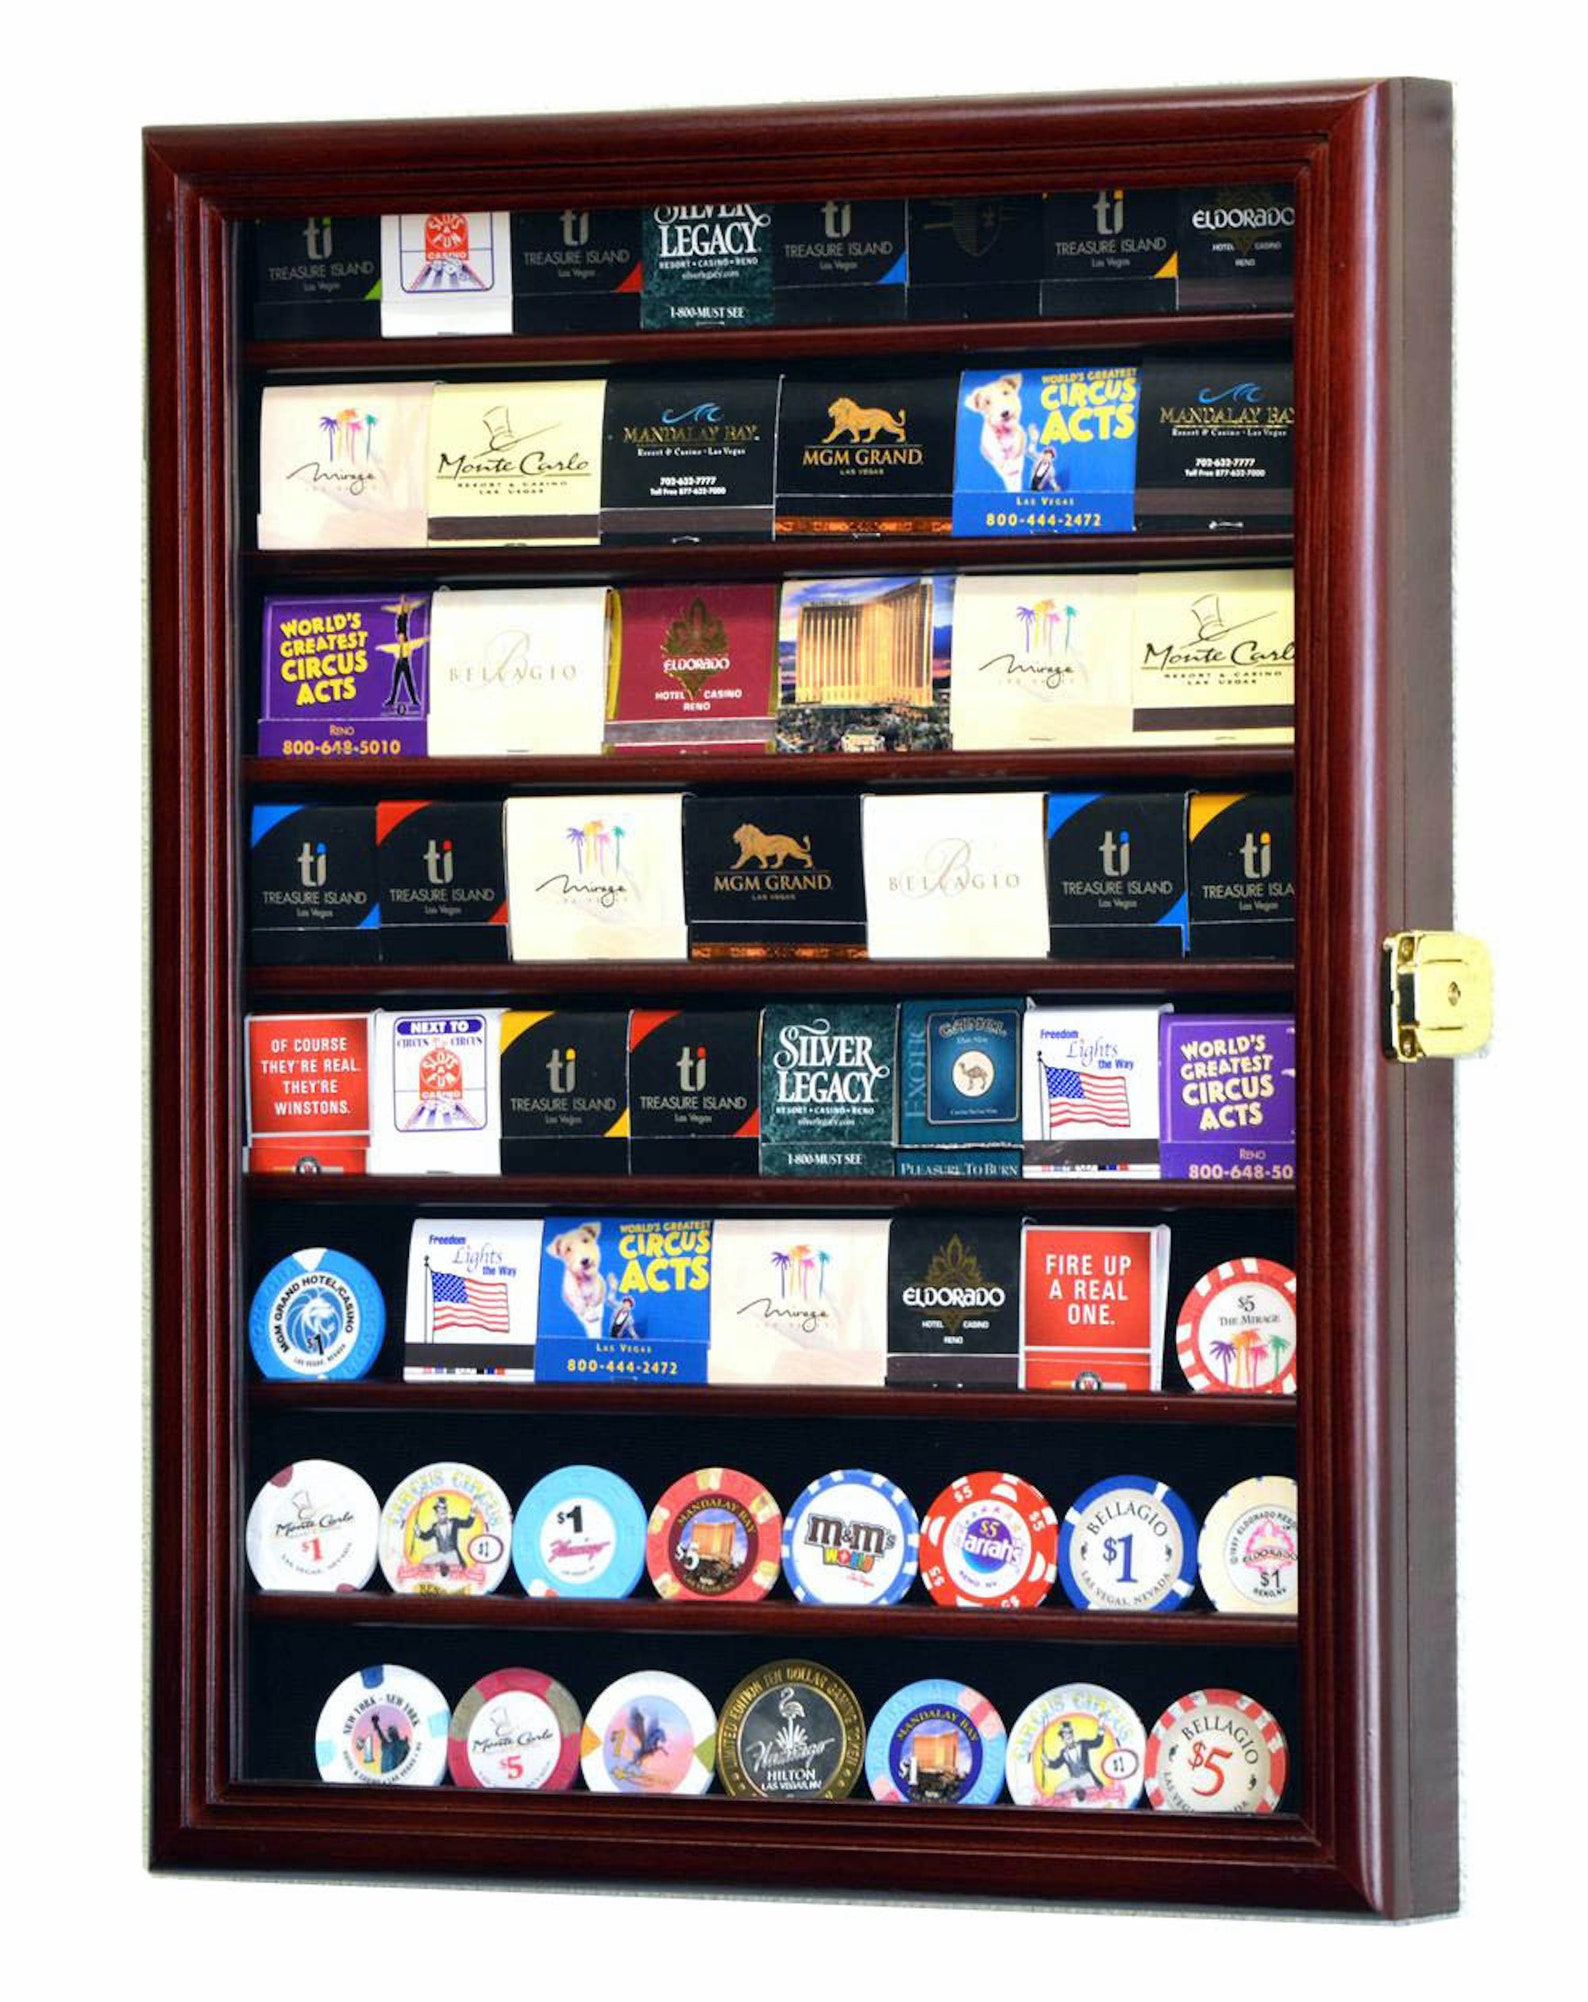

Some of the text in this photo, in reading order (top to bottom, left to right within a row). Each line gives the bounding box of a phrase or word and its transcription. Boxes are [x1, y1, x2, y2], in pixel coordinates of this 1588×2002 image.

[658, 221, 762, 258] LEGACY
[1055, 237, 1166, 256] TREASURE ISLAND
[524, 249, 630, 266] TREASURE ISLAND
[785, 241, 893, 258] TREASURE ISLAND
[268, 261, 374, 280] TREASURE ISLAND
[659, 256, 758, 269] RESORT CASINO RENO
[671, 306, 745, 318] 1-800-MUST SEE
[1041, 368, 1137, 384] WORLD'S GREATEST
[1041, 376, 1137, 410] CIRCUS
[1040, 403, 1135, 445] ACTS
[1172, 429, 1199, 437] Resort
[1211, 428, 1240, 437] Casino
[1247, 428, 1262, 437] Las
[1263, 428, 1287, 438] Vegas
[623, 426, 720, 443] MANDALAY
[637, 448, 663, 457] Resort
[674, 448, 701, 456] Casino
[707, 447, 722, 456] Las
[723, 447, 746, 457] Vegas
[802, 448, 922, 466] MGM GRAND
[437, 451, 590, 480] Monte Carlo
[1195, 458, 1255, 469] 702-632-7777
[659, 476, 716, 487] 702-632-7777
[986, 513, 1102, 528] 800-444-2472
[280, 612, 361, 639] WORLD'S
[280, 630, 368, 658] GREATEST
[281, 650, 369, 682] CIRCUS
[449, 665, 577, 683] BELLAGIO
[295, 678, 356, 706] ACTS
[655, 689, 742, 701] HOTEL CASINO
[683, 702, 711, 711] RENO
[282, 739, 401, 755] 800-648-5010
[423, 839, 454, 886] ti
[1099, 831, 1130, 877] ti
[1240, 832, 1271, 879] ti
[297, 842, 326, 887] ti
[713, 875, 831, 891] MGM GRAND
[888, 873, 1020, 892] BELLAGIO
[1063, 881, 1173, 896] TREASURE ISLAND
[263, 890, 367, 904] TREASURE ISLAND
[390, 889, 495, 903] TREASURE ISLAND
[1098, 899, 1137, 910] Las Vegas
[297, 909, 333, 920] Las Vegas
[425, 905, 462, 917] Las Vegas
[1239, 900, 1278, 912] Las Vegas
[410, 1019, 469, 1035] NEXT TO
[1040, 1029, 1079, 1039] Freedom
[271, 1037, 348, 1053] OF COURSE
[397, 1036, 483, 1049] CIRCUS CIRCUS
[773, 1018, 890, 1079] SILVER
[1066, 1036, 1119, 1067] Lights
[1181, 1034, 1266, 1061] WORLD'S
[261, 1057, 362, 1074] THEY'RE REAL.
[546, 1048, 576, 1094] ti
[676, 1046, 706, 1092] ti
[1098, 1059, 1135, 1071] the Way
[1181, 1054, 1274, 1081] GREATEST
[282, 1079, 338, 1095] THEY'RE
[421, 1090, 461, 1101] CASINO
[776, 1070, 877, 1104] LEGACY
[1182, 1075, 1276, 1107] CIRCUS
[274, 1101, 351, 1116] WINSTONS.
[510, 1098, 616, 1112] TREASURE ISLAND
[640, 1096, 747, 1111] TREASURE ISLAND
[776, 1106, 874, 1115] RESORT CASINO RENO
[1199, 1102, 1264, 1131] ACTS
[788, 1154, 863, 1165] 1-800-MUST SEE
[1188, 1164, 1294, 1180] 800-648-50
[619, 1220, 711, 1233] WORLD'S GREATEST
[429, 1234, 466, 1246] Freedom
[619, 1230, 710, 1259] CIRCUS
[452, 1242, 503, 1273] Lights
[1045, 1254, 1132, 1277] FIRE UP
[482, 1266, 518, 1278] the Way
[619, 1256, 709, 1293] ACTS
[1049, 1279, 1128, 1301] A REAL
[1238, 1294, 1256, 1313] $5
[275, 1275, 354, 1354] MGM GRAND HOTEL/CASINO
[1067, 1304, 1116, 1326] ONE.
[1219, 1313, 1281, 1326] THE MIRAGE
[922, 1320, 989, 1330] HOTEL CASINO
[943, 1335, 963, 1345] RENO
[567, 1358, 678, 1375] 800-444-2472
[953, 1485, 974, 1503] $5
[557, 1505, 584, 1533] $1
[679, 1499, 757, 1534] MANDALAY BAY
[1028, 1511, 1046, 1533] $5
[1087, 1500, 1168, 1538] BELLAGIO
[980, 1520, 1001, 1539] $5
[301, 1537, 323, 1561] $1
[674, 1542, 700, 1571] $5
[1102, 1532, 1138, 1584] $1
[824, 1548, 875, 1573] WORLD
[928, 1565, 946, 1588] $5
[1259, 1568, 1281, 1588] $1
[897, 1708, 979, 1742] MANDALAY BAY
[1181, 1715, 1259, 1765] BELLAGIO
[499, 1755, 525, 1781] $5
[767, 1768, 816, 1781] HILTON
[898, 1754, 919, 1786] $1
[1187, 1739, 1233, 1798] $5
